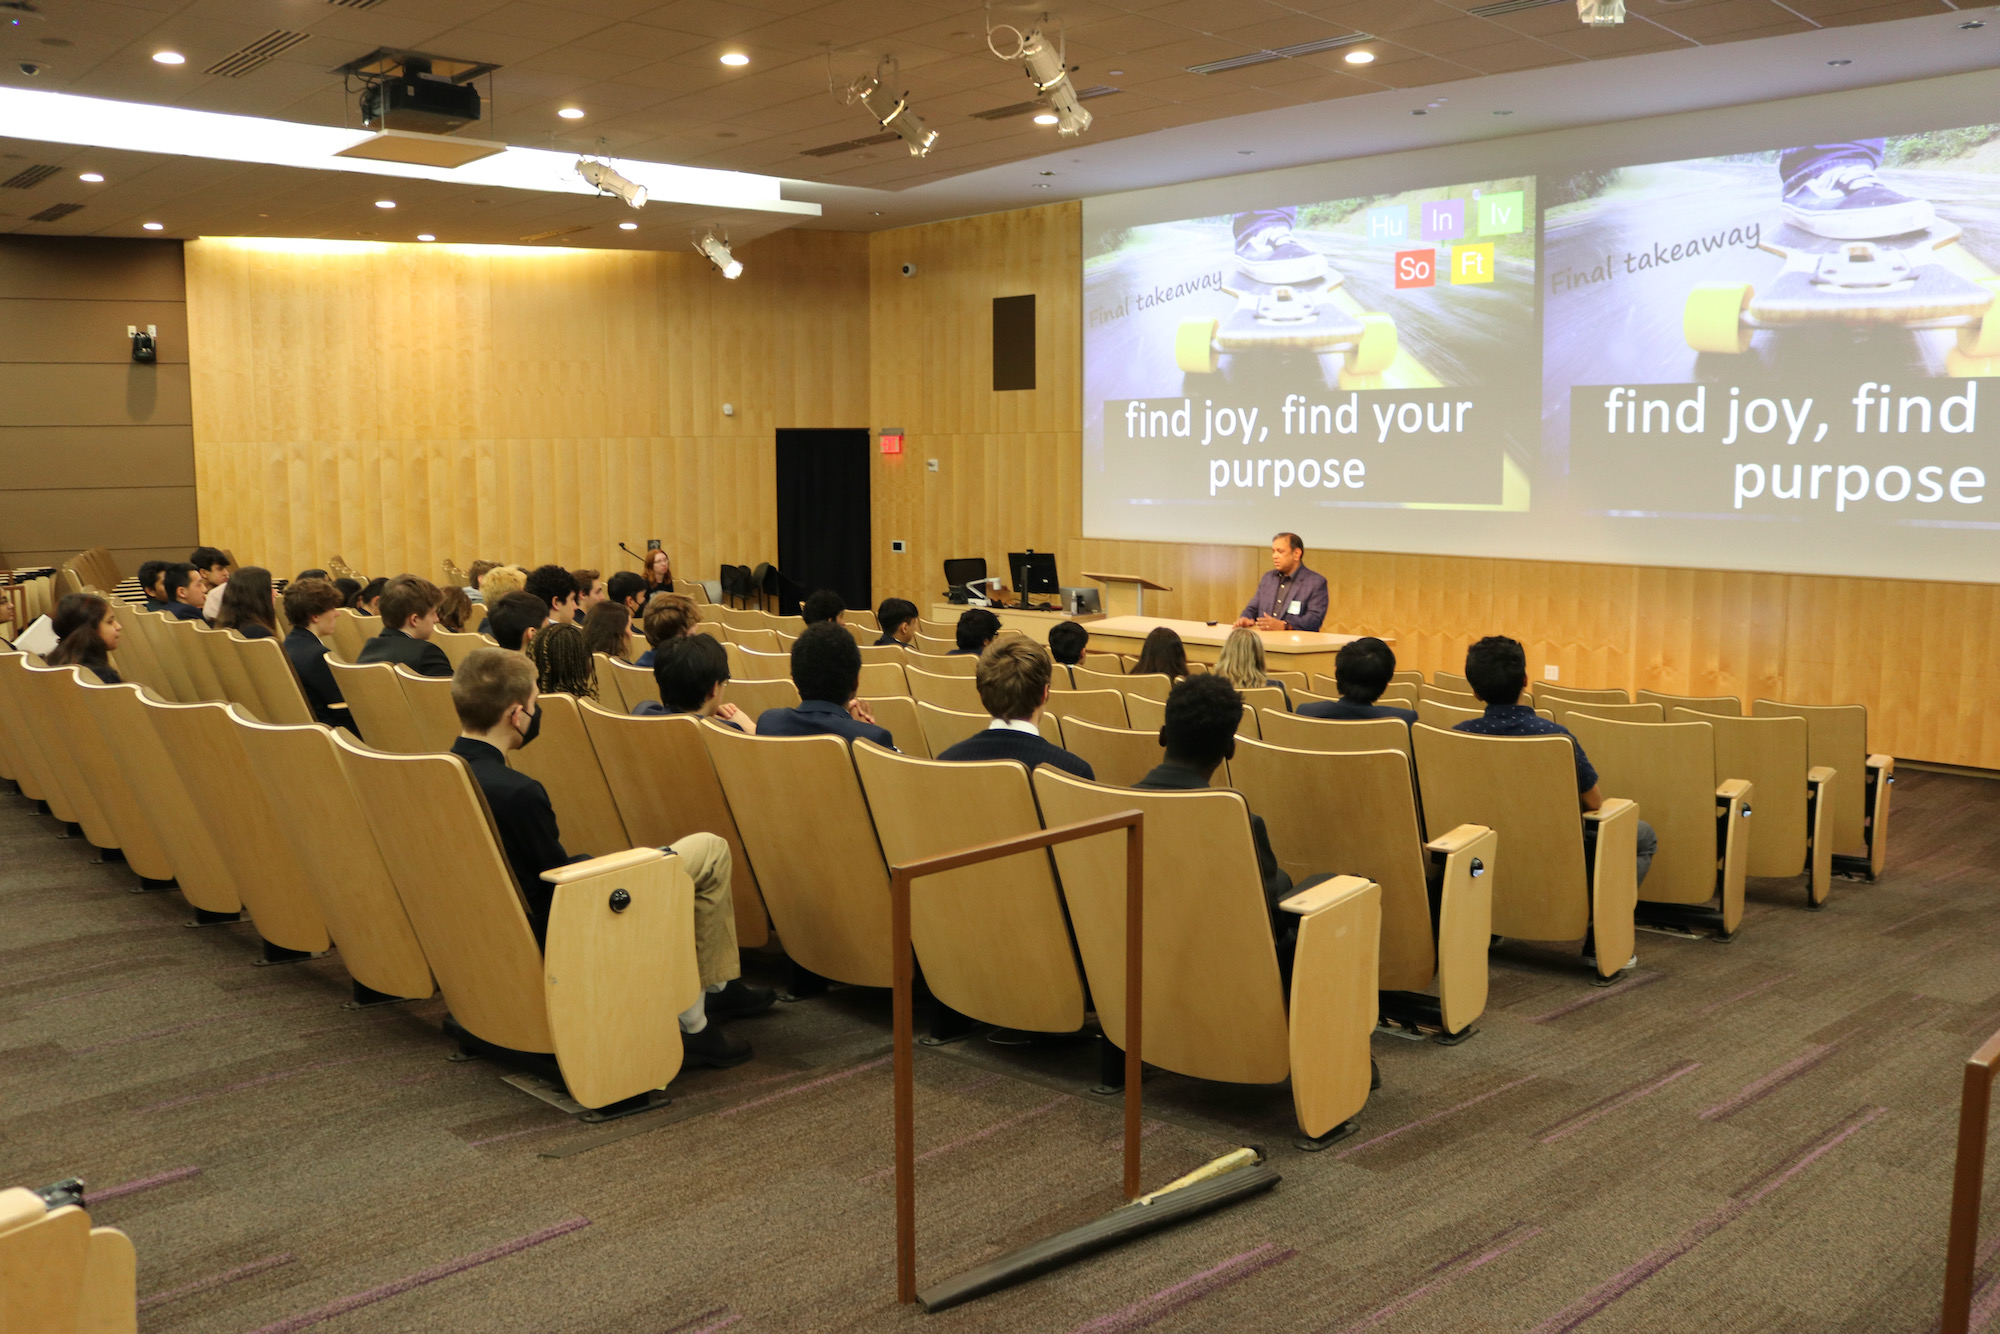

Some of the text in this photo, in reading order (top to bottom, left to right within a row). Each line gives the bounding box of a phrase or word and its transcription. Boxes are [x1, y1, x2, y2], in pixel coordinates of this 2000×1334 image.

[1371, 202, 1512, 239] Hu In Iv
[1399, 251, 1484, 281] So Ft
[1551, 222, 1760, 295] Final takeaway
[1089, 270, 1223, 328] Final takeaway
[1125, 392, 1473, 445] find joy, find your
[1604, 380, 1976, 445] find joy, find
[1210, 457, 1365, 497] purpose
[1733, 463, 1985, 512] purpose
